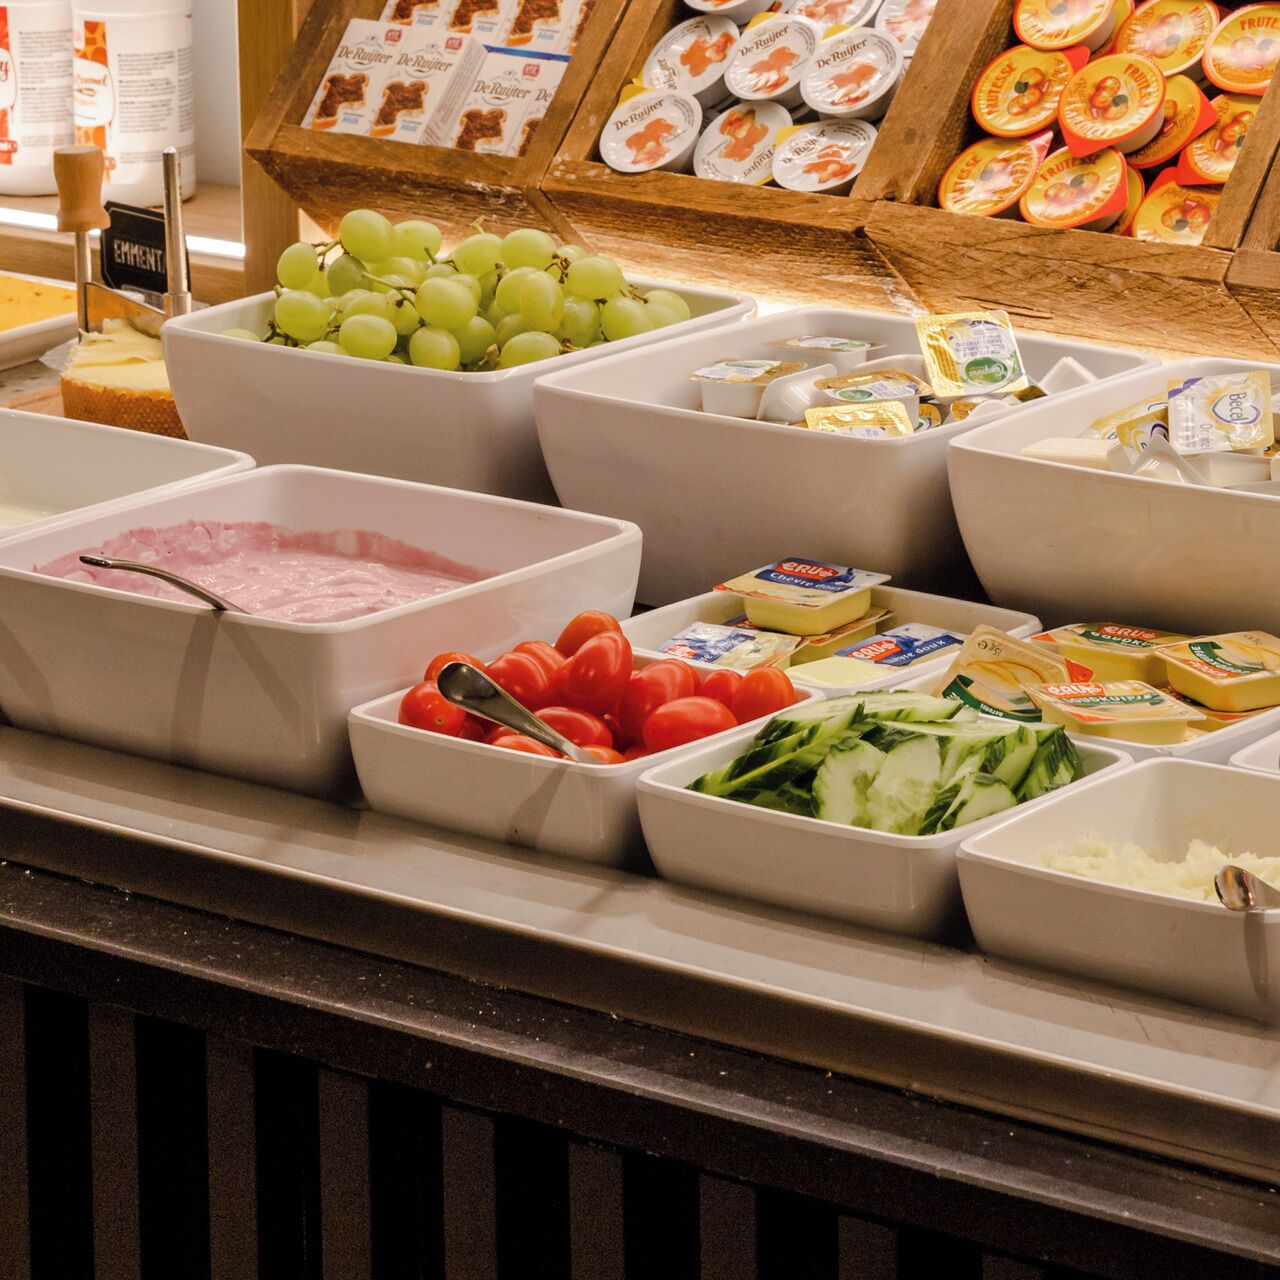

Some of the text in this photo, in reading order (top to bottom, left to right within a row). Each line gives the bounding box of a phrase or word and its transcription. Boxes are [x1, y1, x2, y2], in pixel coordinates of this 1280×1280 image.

[739, 25, 790, 57] De Ruijter
[337, 46, 393, 64] De Ruijter
[396, 53, 453, 72] De Ruijter
[816, 38, 868, 70] De Ruijter
[474, 81, 531, 100] De Ruijter
[535, 88, 552, 102] De
[615, 98, 664, 131] De Ruijter
[1229, 391, 1249, 421] Becel
